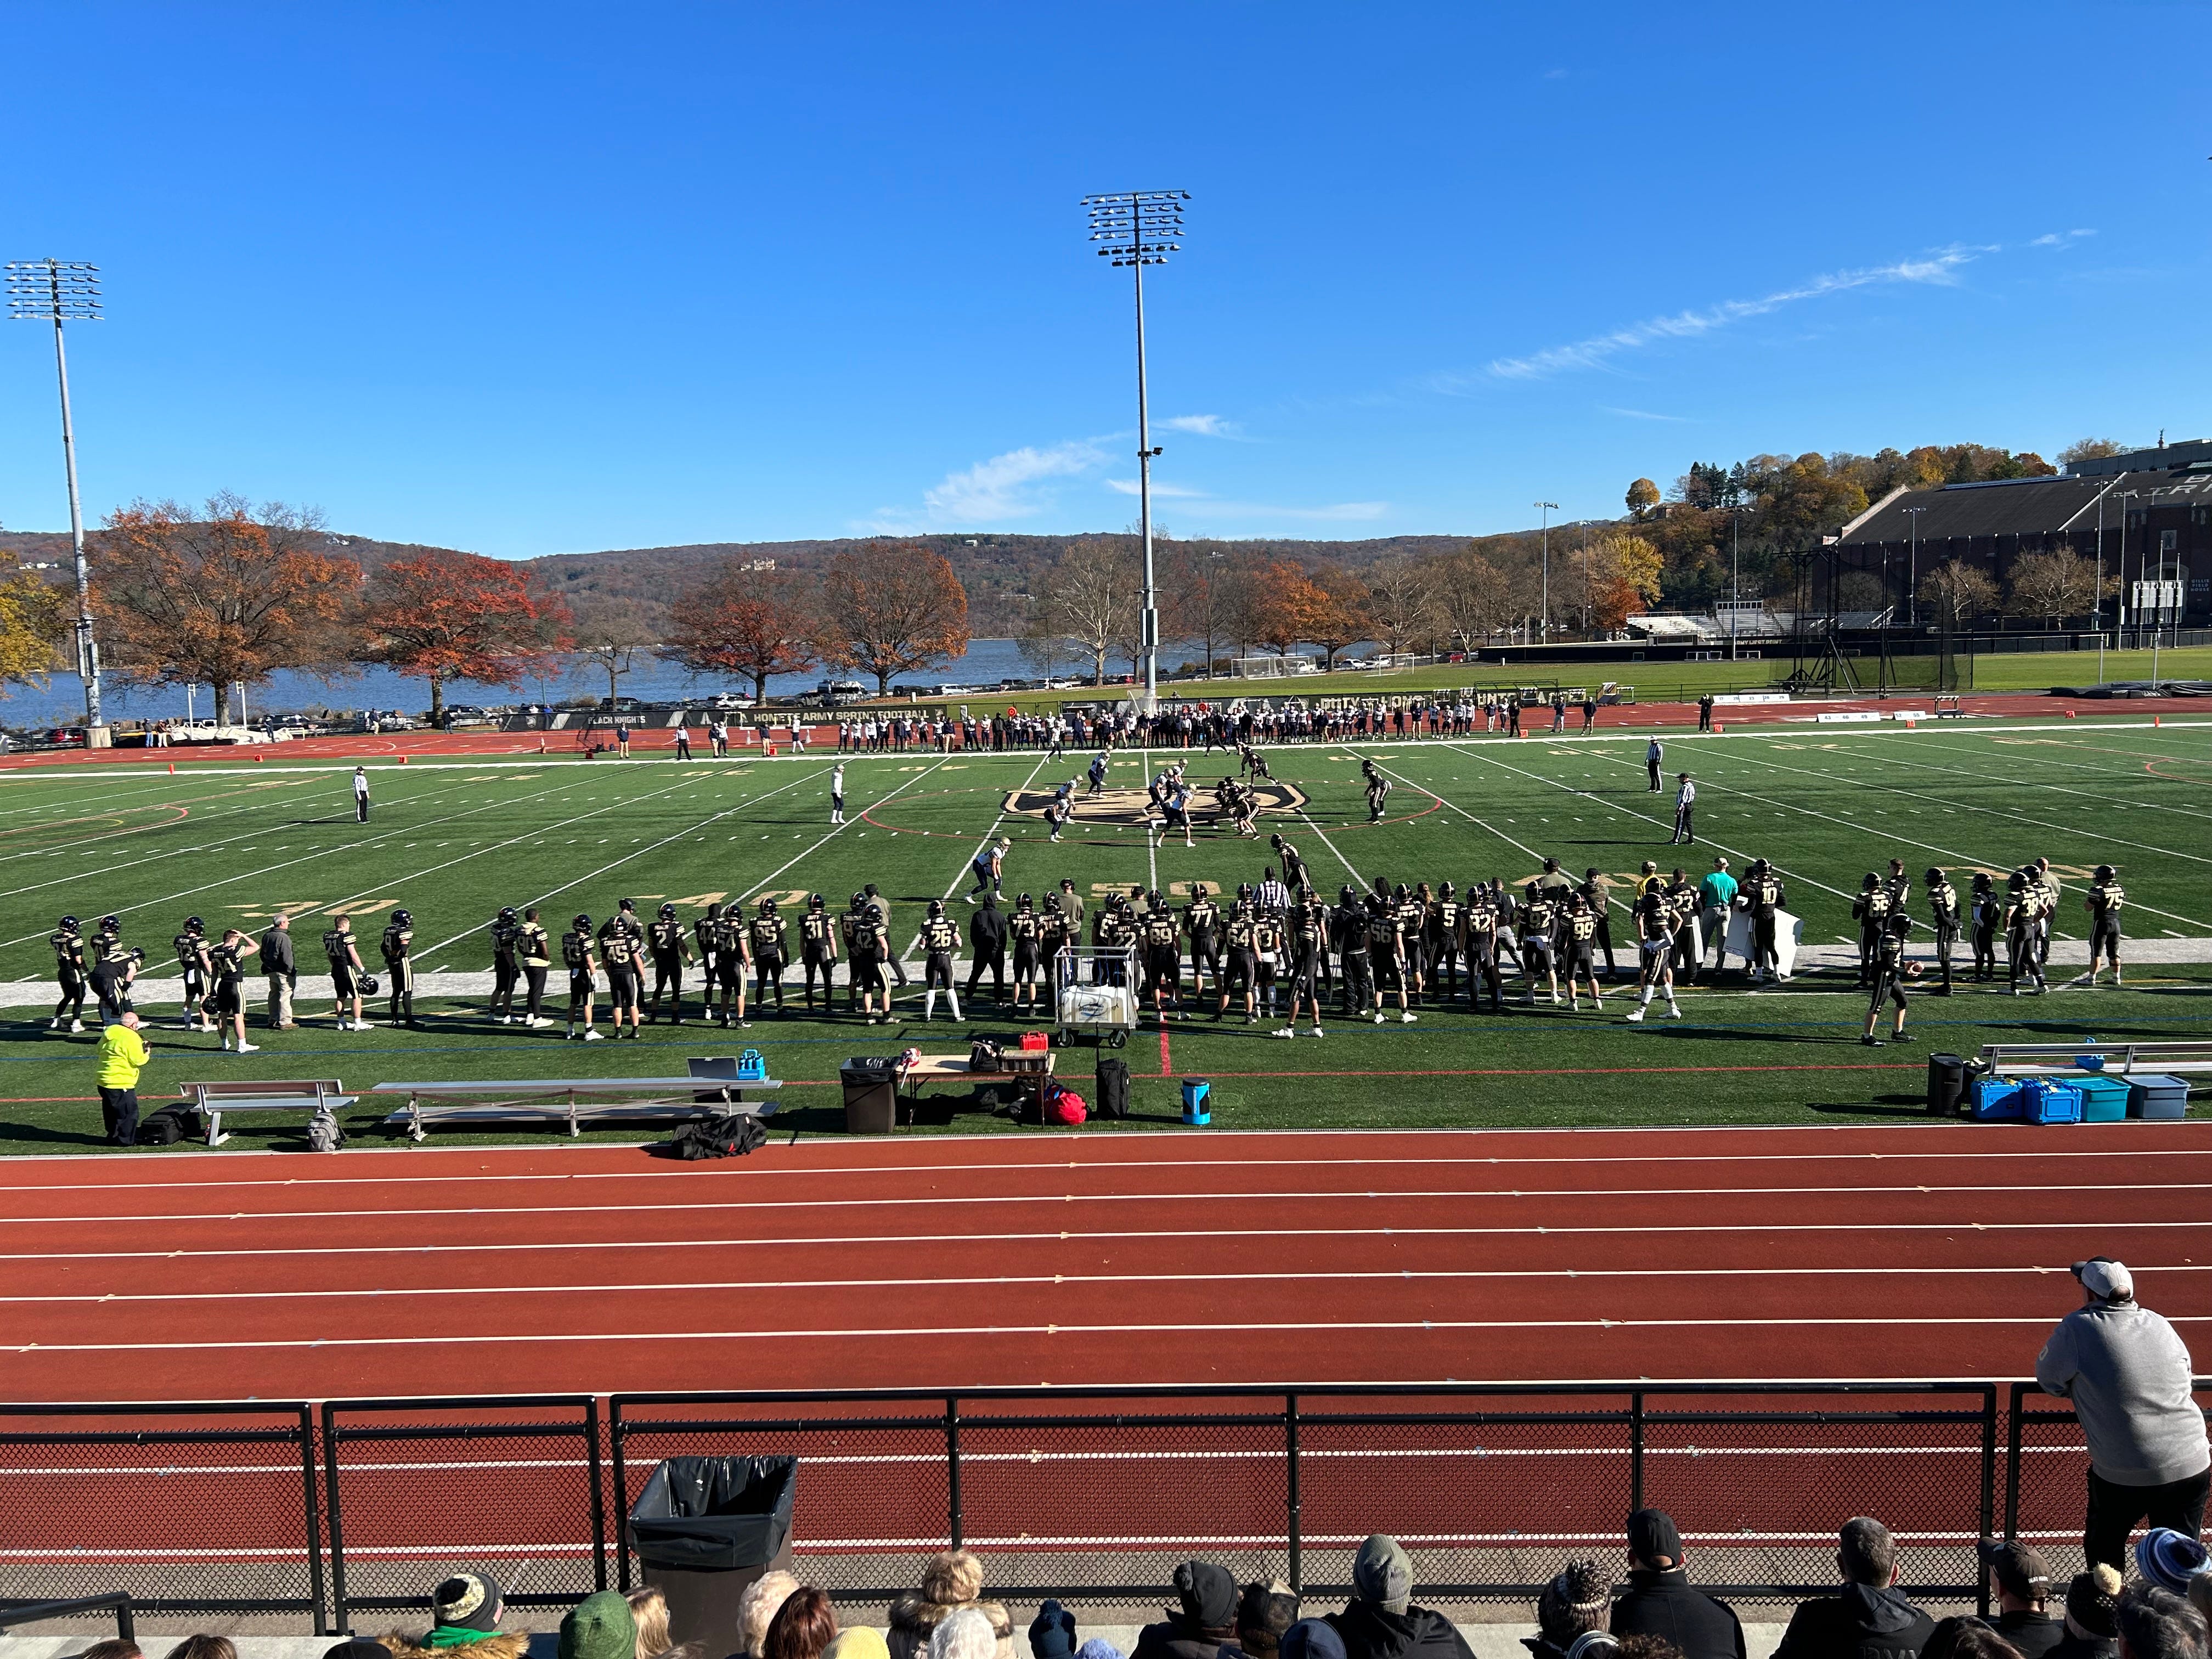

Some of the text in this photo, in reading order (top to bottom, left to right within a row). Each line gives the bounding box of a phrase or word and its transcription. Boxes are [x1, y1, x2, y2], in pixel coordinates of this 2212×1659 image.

[1321, 697, 1360, 709] DUTY
[614, 715, 646, 724] KNIGHTS
[803, 712, 834, 721] ARMY
[878, 709, 929, 719] FOOTBALL
[1091, 880, 1221, 898] 50
[1763, 887, 1778, 904] 10
[662, 890, 810, 907] 40
[1672, 894, 1693, 912] 23
[2021, 897, 2039, 917] 38
[2104, 892, 2124, 911] 75
[1189, 909, 1213, 928] 77
[1443, 909, 1455, 927] 5
[1469, 913, 1491, 933] 82
[699, 927, 716, 944] 44
[753, 926, 777, 943] 95
[805, 920, 823, 939] 31
[1012, 919, 1035, 938] 73
[1149, 927, 1172, 945] 89
[1226, 928, 1249, 947] 64
[1370, 923, 1391, 943] 56
[1573, 921, 1594, 940] 99
[517, 935, 536, 953] 90
[656, 930, 668, 949] 2
[716, 933, 737, 952] 54
[856, 931, 874, 949] 42
[930, 929, 952, 947] 26
[1113, 932, 1136, 949] 22
[606, 945, 629, 963] 45
